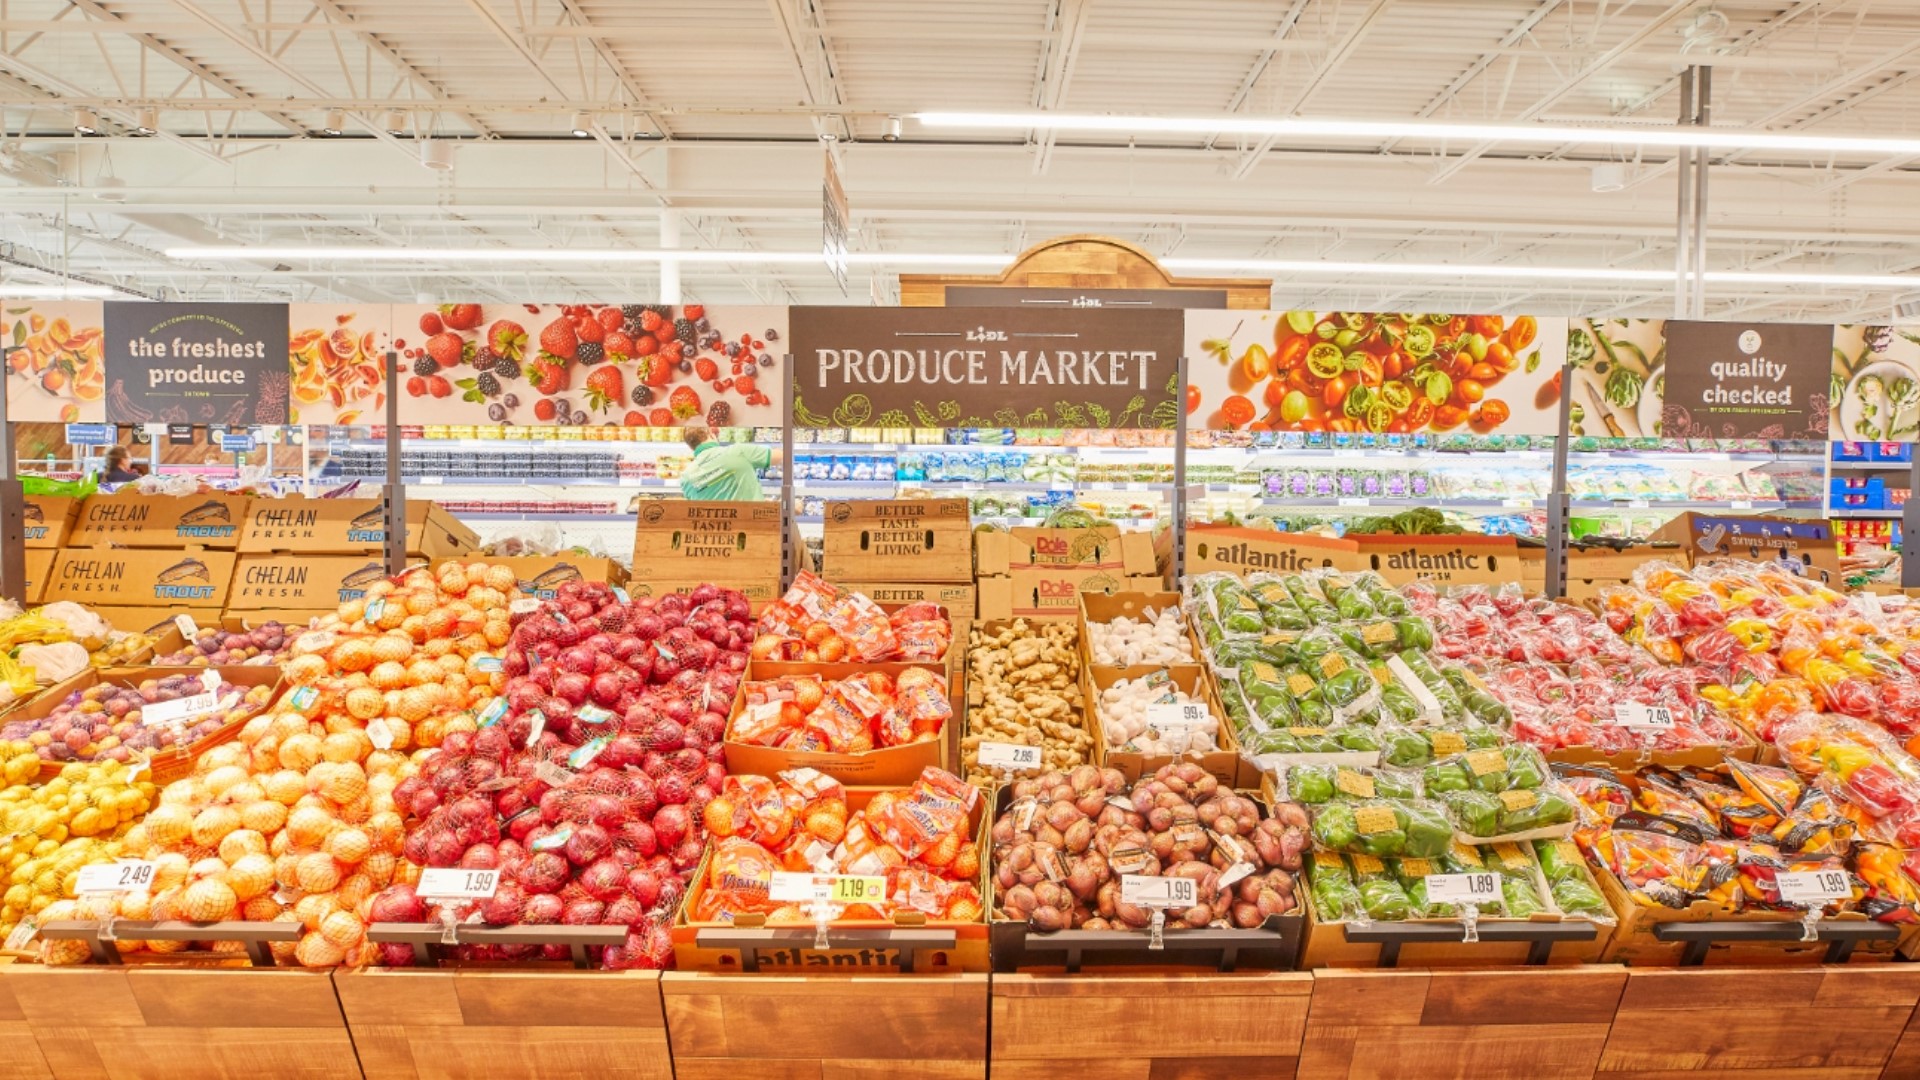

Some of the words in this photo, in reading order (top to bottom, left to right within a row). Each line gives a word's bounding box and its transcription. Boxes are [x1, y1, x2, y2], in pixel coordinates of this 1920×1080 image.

[966, 325, 1008, 342] LIDL
[129, 337, 167, 358] the
[171, 337, 265, 358] freshest
[148, 364, 246, 388] produce
[815, 349, 988, 388] PRODUCE
[1000, 350, 1157, 390] MARKET
[1710, 358, 1787, 382] quality
[1702, 385, 1792, 405] checked
[89, 504, 150, 522] CHELAN
[255, 509, 318, 527] CHELAN
[687, 507, 739, 519] BETTER
[875, 505, 926, 517] BETTER
[176, 525, 237, 538] TROUT
[692, 520, 732, 532] TASTE
[879, 518, 919, 529] TASTE
[347, 530, 386, 542] TRO
[684, 533, 736, 546] BETTER
[873, 530, 925, 543] BETTER
[1036, 536, 1068, 550] Dole
[685, 546, 731, 558] LIVING
[875, 544, 921, 555] LIVING
[1215, 542, 1313, 571] atlantic
[1387, 548, 1480, 571] atlantic
[63, 560, 125, 579] CHELAN
[245, 566, 308, 585] CHELAN
[154, 584, 216, 599] TROUT
[873, 589, 925, 601] BETTER
[1039, 579, 1075, 596] Dole
[1039, 598, 1077, 606] LETTUCE
[1646, 708, 1670, 724] 2.49
[118, 865, 152, 885] 2.49
[465, 872, 494, 892] 1.99
[1467, 874, 1494, 893] 1.89
[1816, 872, 1846, 892] 1.99
[839, 878, 864, 898] 1.19
[1165, 880, 1191, 901] 1.99
